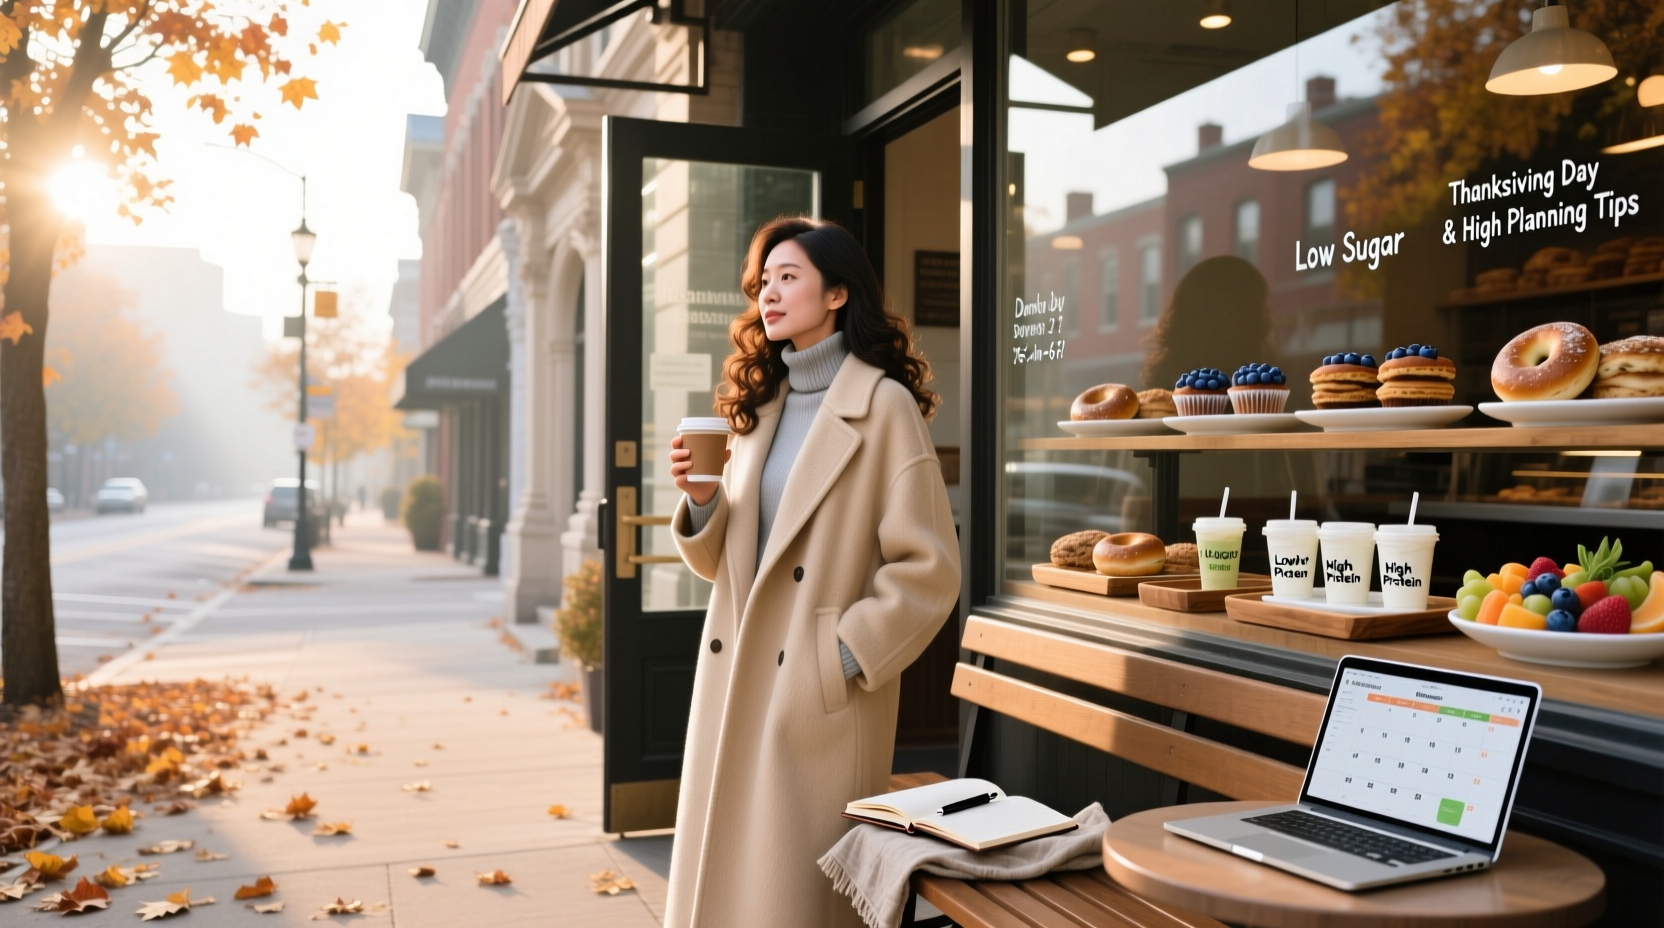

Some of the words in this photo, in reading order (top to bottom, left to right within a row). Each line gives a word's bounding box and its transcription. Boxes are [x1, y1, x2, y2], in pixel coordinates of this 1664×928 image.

[1448, 168, 1554, 206] Thanksiving
[1561, 159, 1600, 191] Day
[1442, 219, 1457, 245] &
[1462, 212, 1502, 248] High
[1507, 202, 1587, 234] Planning
[1593, 190, 1640, 228] Tips
[1295, 240, 1335, 272] Low
[1342, 231, 1405, 271] Sugar
[1385, 562, 1412, 577] High
